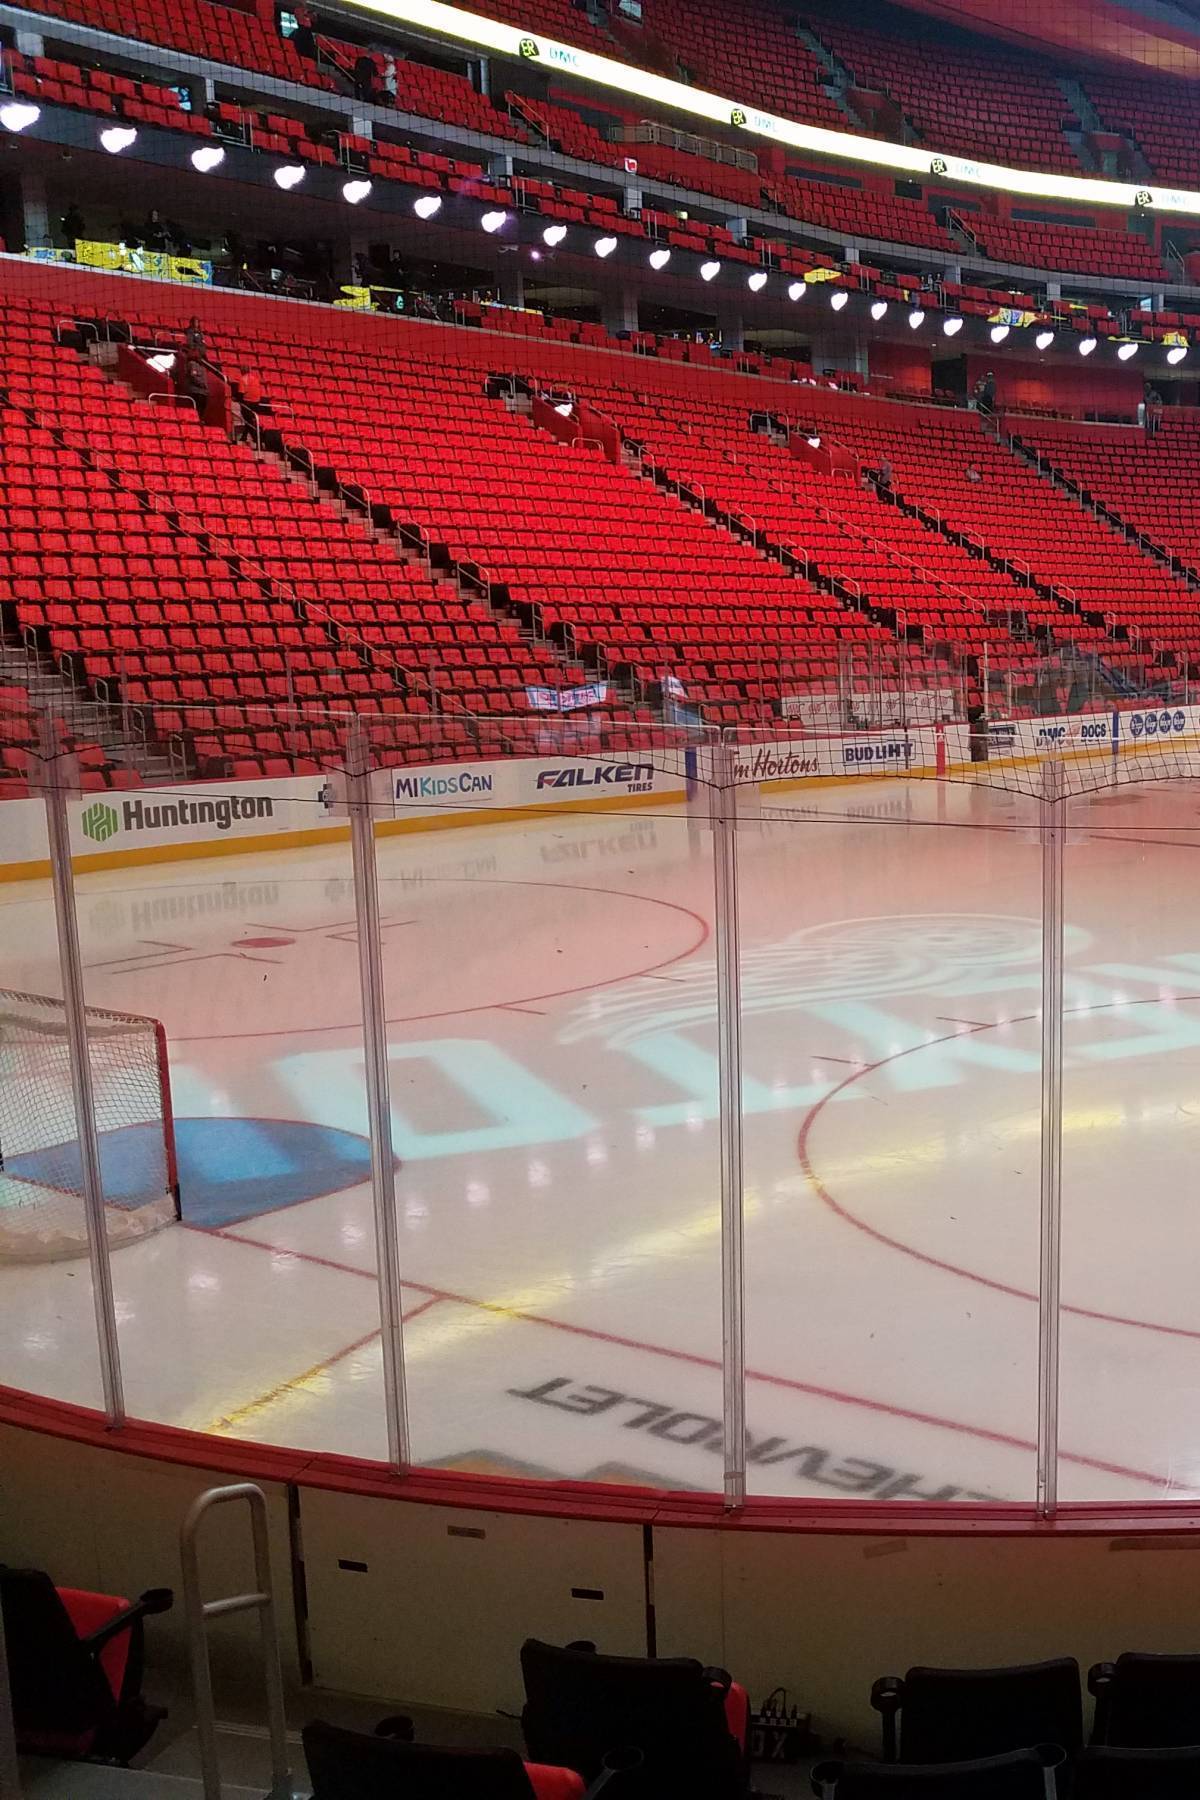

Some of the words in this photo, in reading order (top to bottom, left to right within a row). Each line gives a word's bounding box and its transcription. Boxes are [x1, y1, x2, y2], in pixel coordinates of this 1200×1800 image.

[1080, 723, 1107, 742] DOCS
[751, 748, 818, 777] Hortons
[845, 746, 874, 761] BUD
[536, 763, 654, 789] FALKEN
[627, 782, 653, 792] TIRES
[122, 795, 274, 831] Huntington
[506, 1376, 1012, 1500] HEVROLET
